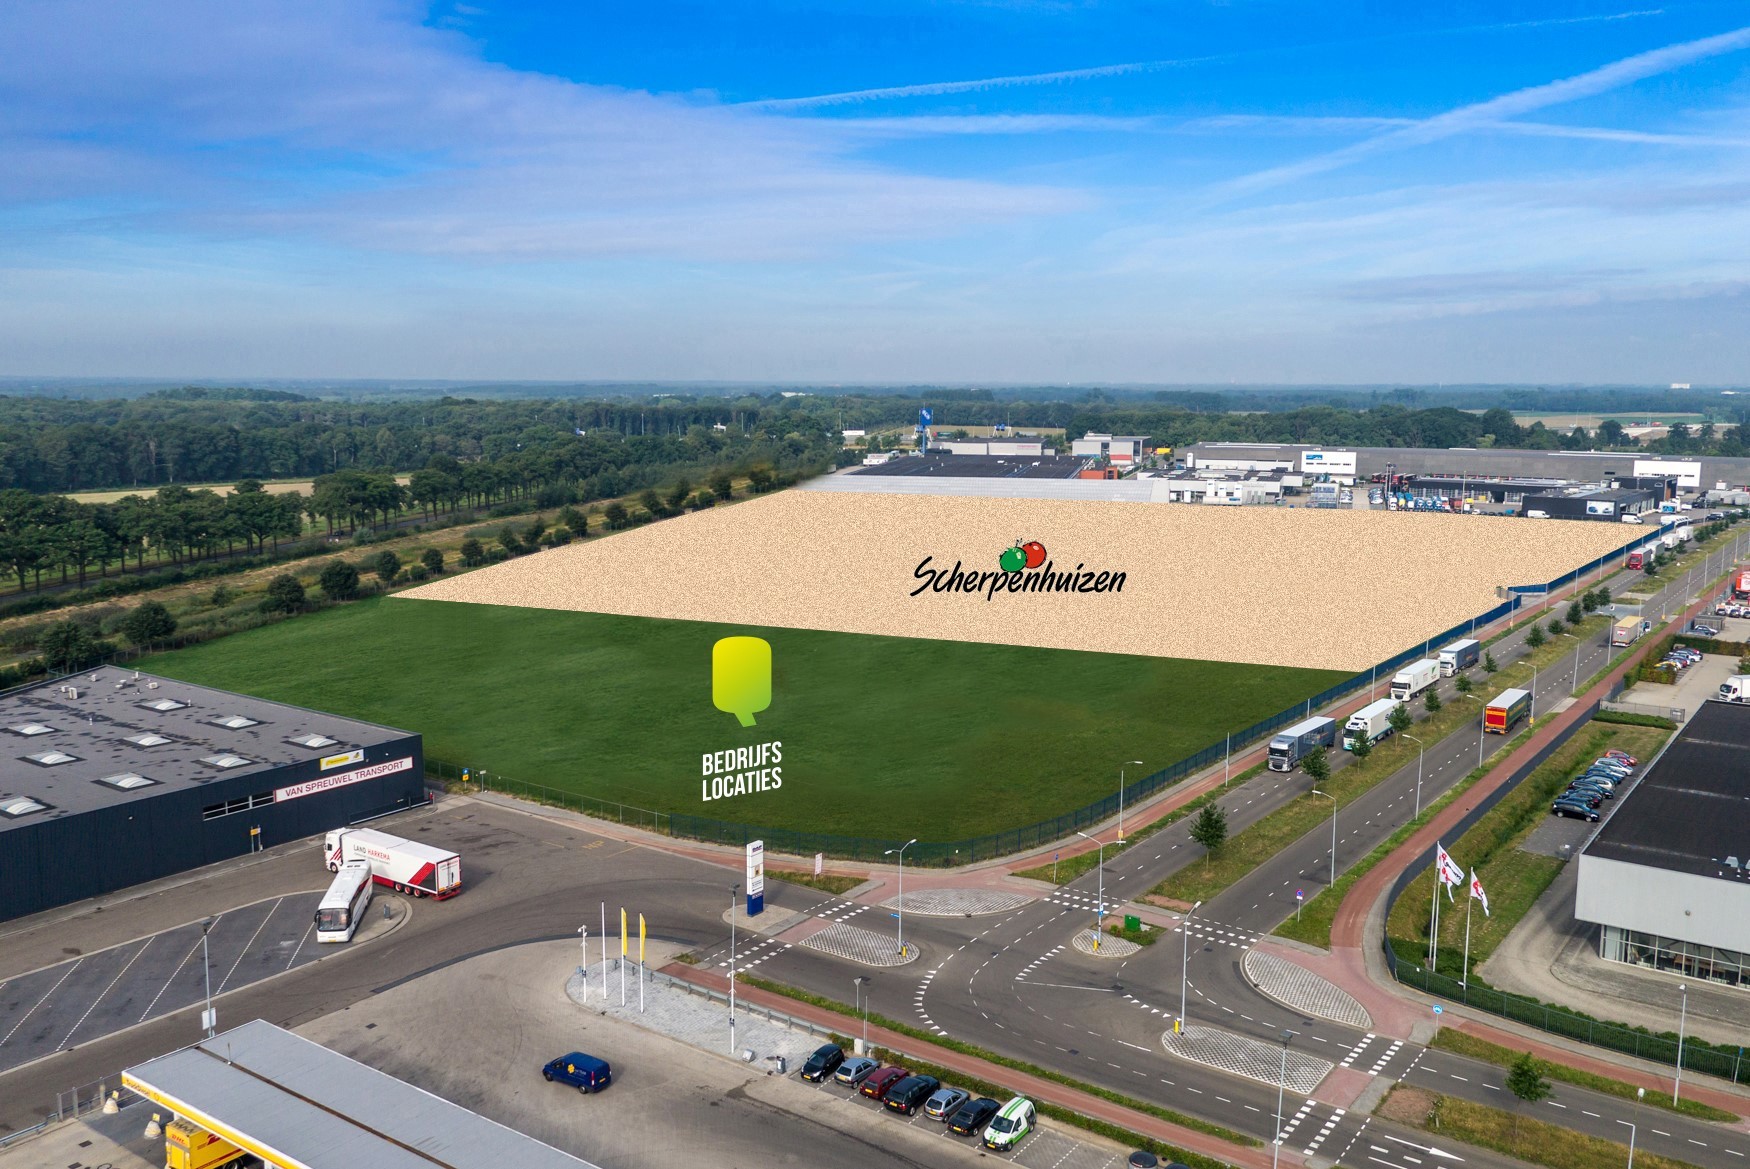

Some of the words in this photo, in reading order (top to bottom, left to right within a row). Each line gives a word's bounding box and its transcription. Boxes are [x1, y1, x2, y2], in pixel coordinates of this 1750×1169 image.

[285, 786, 303, 797] VAN
[305, 774, 353, 792] SPREUWEL
[355, 760, 404, 779] TRANSPORT
[353, 844, 367, 854] LAND
[367, 848, 391, 861] HARKEMA
